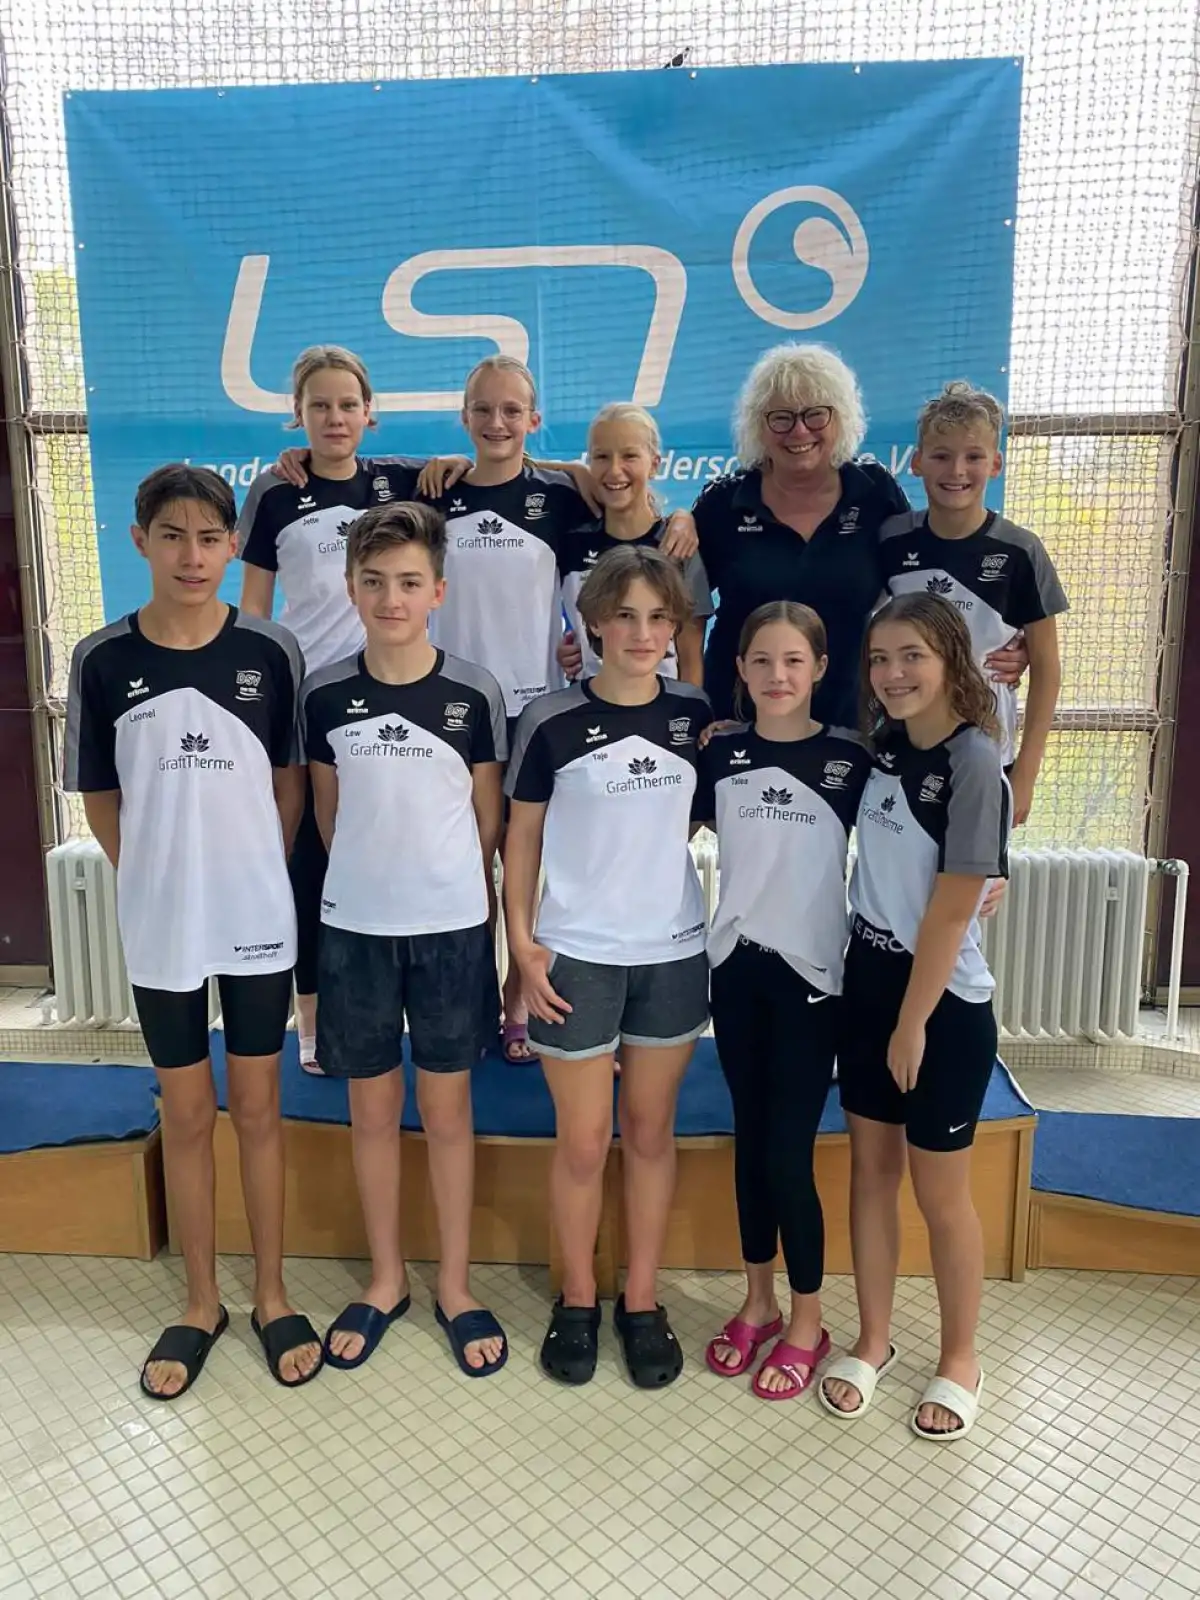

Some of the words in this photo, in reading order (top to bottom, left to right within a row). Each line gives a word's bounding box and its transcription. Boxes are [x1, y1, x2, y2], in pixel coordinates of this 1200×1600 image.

[738, 525, 764, 533] erima
[456, 535, 525, 549] GraftTherme
[981, 555, 1007, 569] DSV
[235, 671, 262, 687] DSV
[127, 686, 150, 699] erima
[128, 708, 156, 723] Leonel
[443, 703, 469, 719] DSV
[345, 727, 362, 737] Lew
[668, 719, 690, 732] DSV
[350, 742, 434, 759] GraftTherme
[158, 754, 235, 772] GraftTherme
[823, 761, 851, 778] DSV
[606, 773, 683, 795] GraftTherme
[738, 805, 817, 826] GraftTherme
